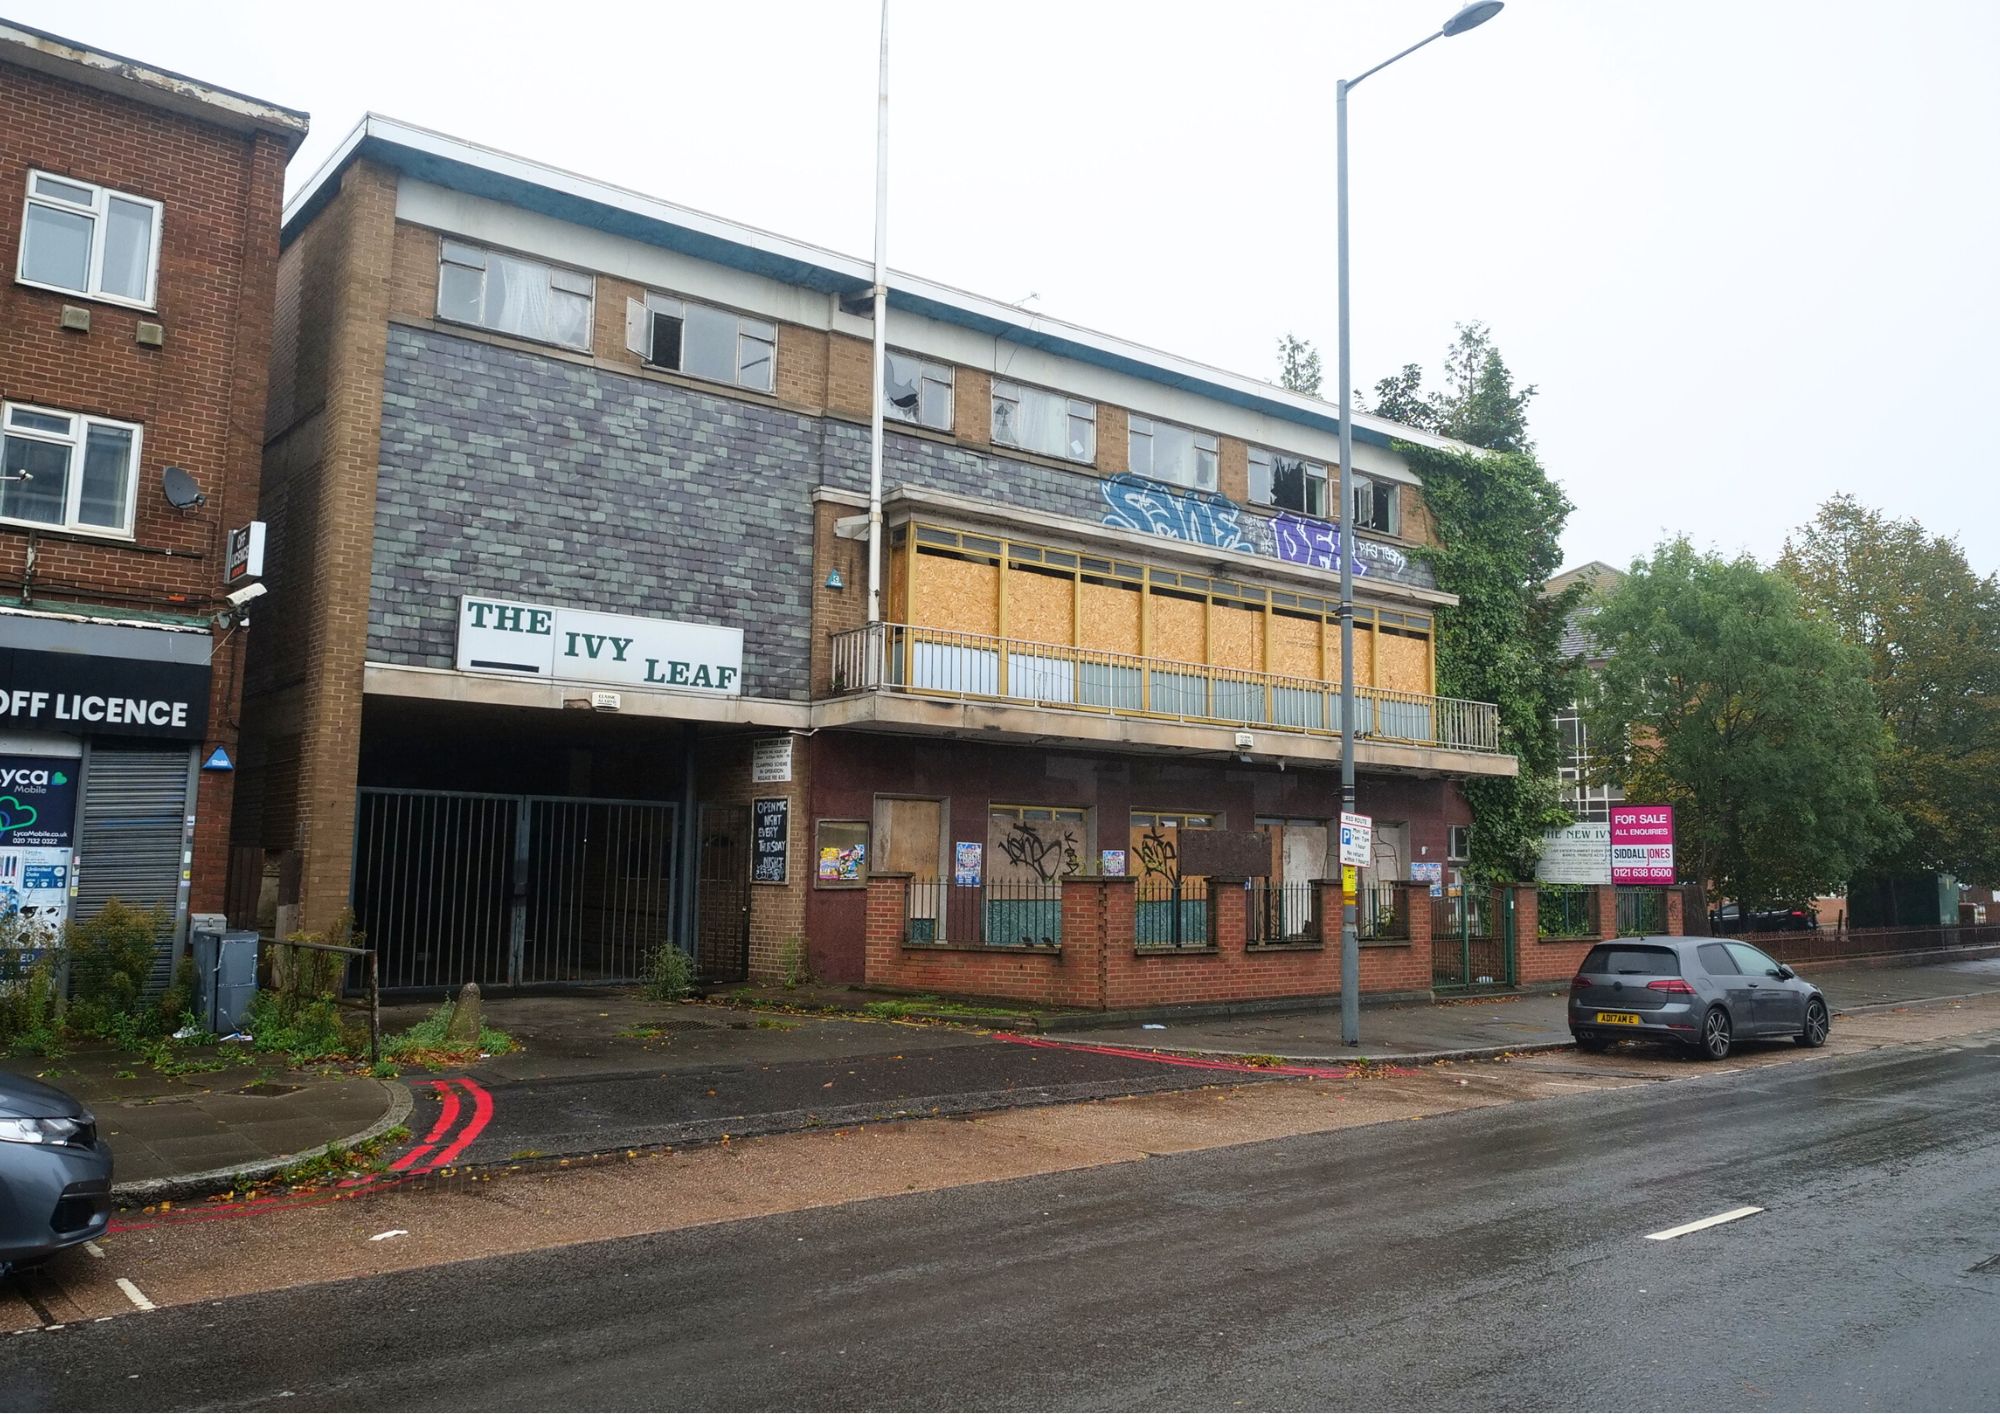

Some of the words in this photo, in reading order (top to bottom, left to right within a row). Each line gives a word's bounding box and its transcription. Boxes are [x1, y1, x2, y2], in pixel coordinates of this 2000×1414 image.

[467, 602, 552, 636] THE
[564, 631, 633, 662] IVY
[644, 658, 738, 689] LEAF
[55, 693, 188, 727] LICENCE
[0, 769, 48, 787] yca
[14, 785, 47, 794] Mobile
[1354, 817, 1367, 825] ROUTE
[1615, 815, 1636, 824] FOR
[1639, 814, 1667, 824] SALE
[13, 830, 68, 838] LycaMobile.co.uk
[758, 826, 778, 838] EVERY
[1343, 829, 1350, 845] P
[1545, 830, 1561, 839] HE
[1567, 830, 1591, 839] NEW
[1630, 828, 1668, 836] ENQUIRIES
[1614, 848, 1646, 859] SIDDALL
[1647, 848, 1671, 866] JONES
[1614, 868, 1630, 877] 0121
[1633, 868, 1648, 877] 638
[1650, 868, 1672, 877] 0500
